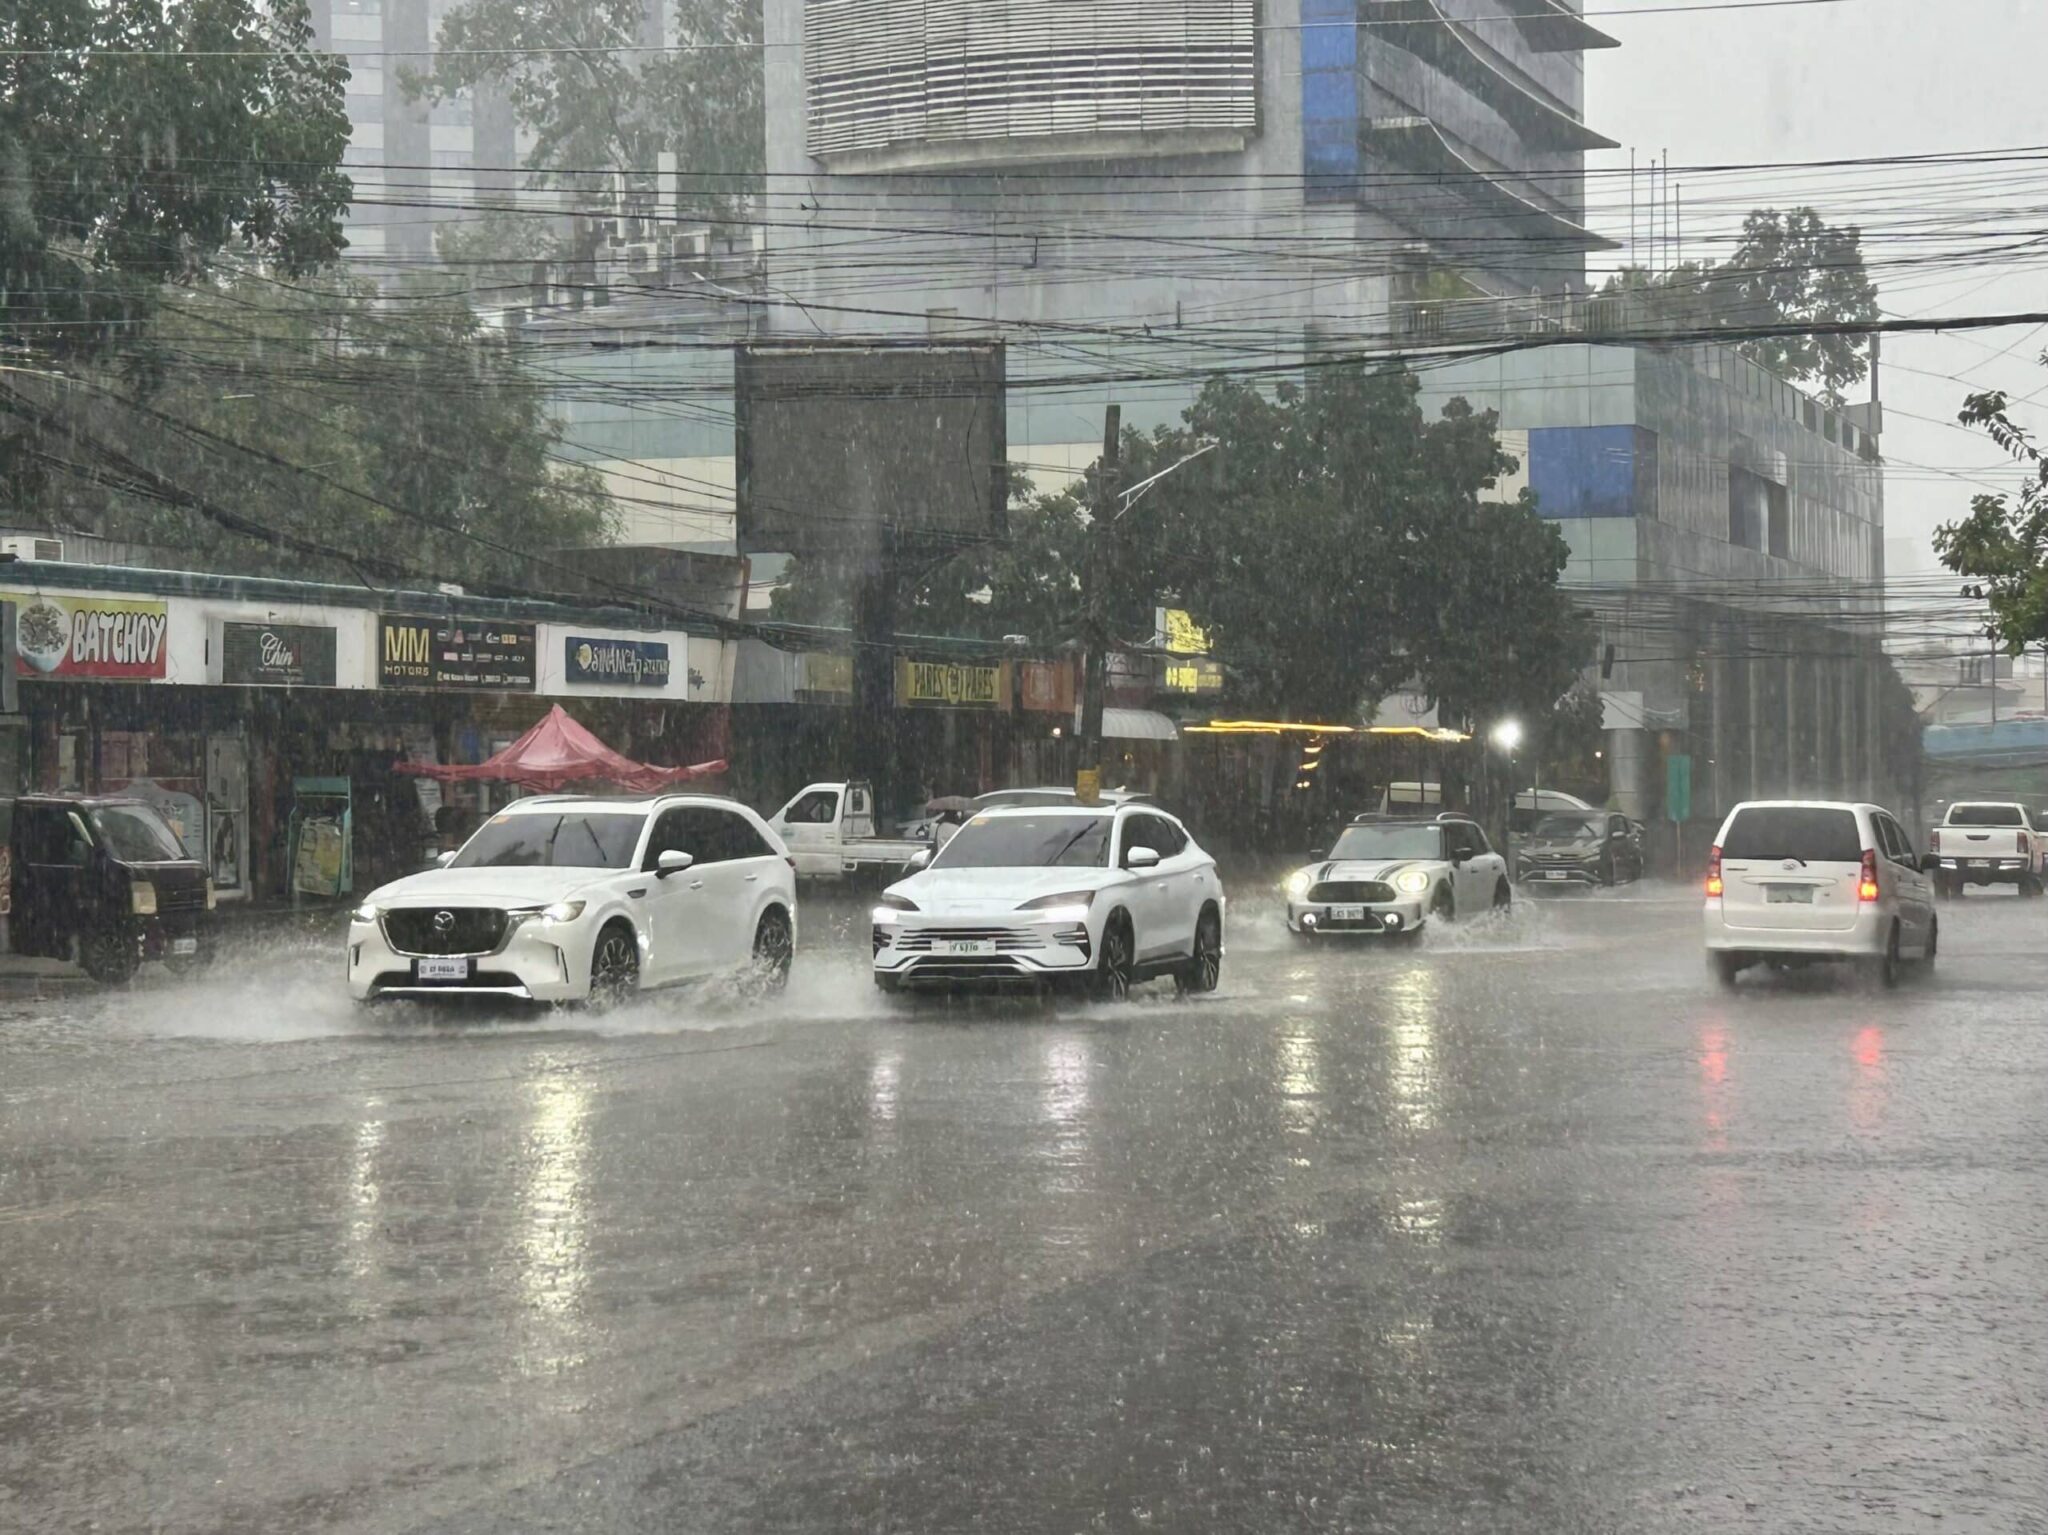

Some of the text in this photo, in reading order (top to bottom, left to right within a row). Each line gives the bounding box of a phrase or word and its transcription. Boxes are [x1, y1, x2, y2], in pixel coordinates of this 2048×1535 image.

[71, 609, 167, 666] BATCHOY
[385, 625, 430, 663] MM
[384, 665, 430, 677] MOTORS
